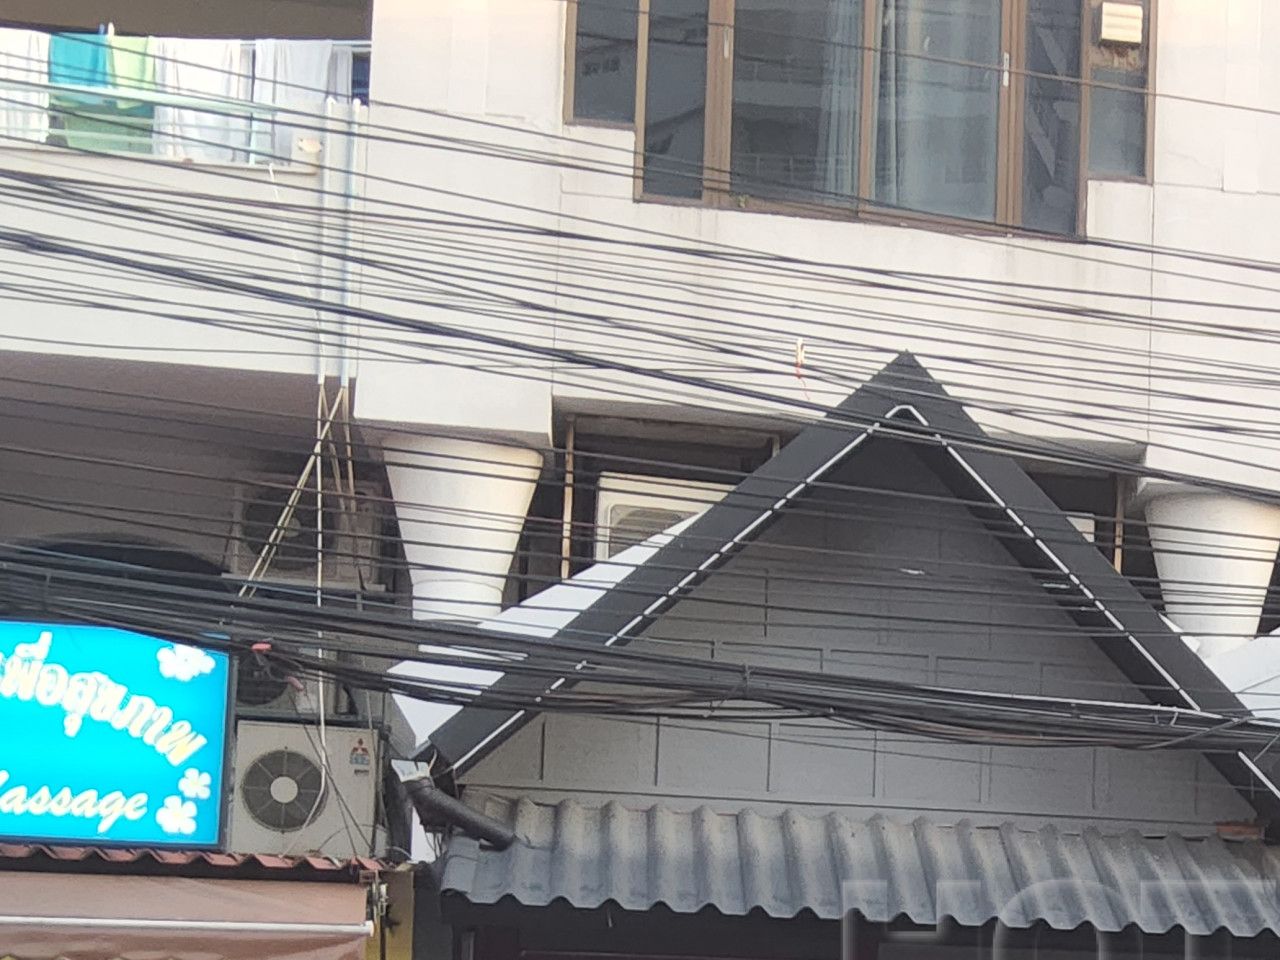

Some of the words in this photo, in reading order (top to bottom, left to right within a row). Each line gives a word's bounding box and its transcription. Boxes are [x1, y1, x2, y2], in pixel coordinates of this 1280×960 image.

[0, 631, 208, 767] พื่อสุขภาพ
[0, 770, 148, 834] assage
